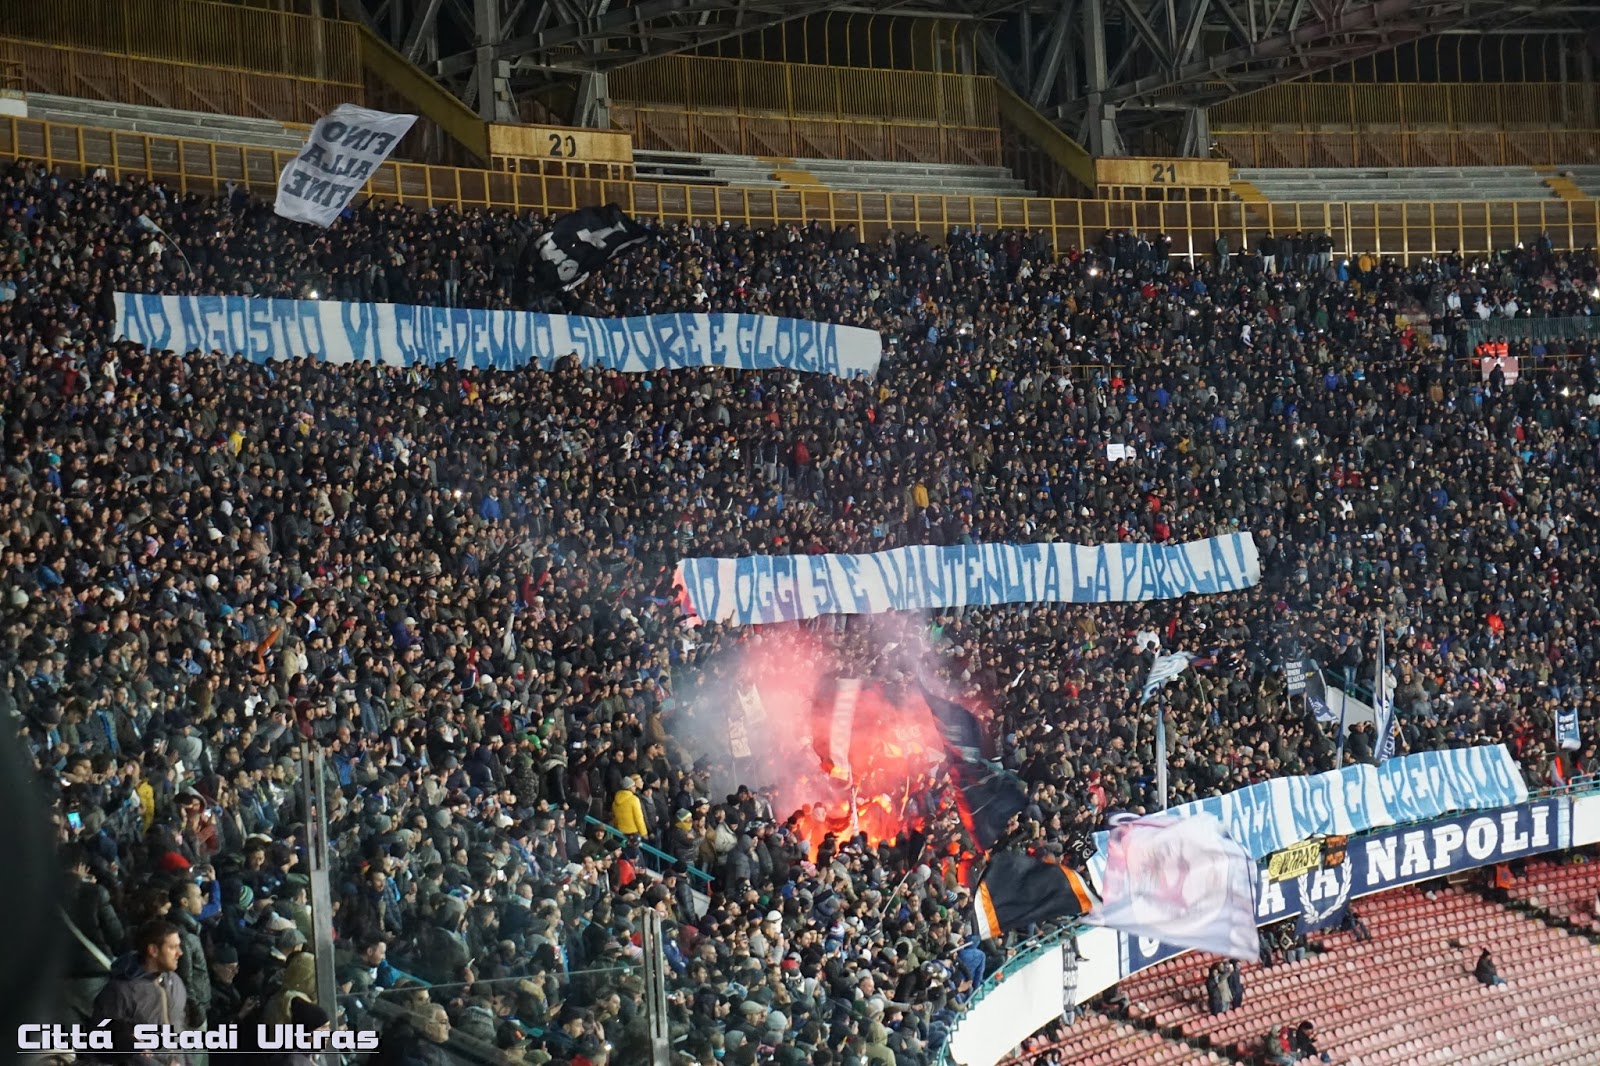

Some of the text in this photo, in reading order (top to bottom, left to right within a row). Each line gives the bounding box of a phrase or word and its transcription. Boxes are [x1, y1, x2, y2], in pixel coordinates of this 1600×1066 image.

[1152, 163, 1176, 183] 21
[124, 293, 171, 351] AD
[179, 295, 327, 363] AGOSTO
[341, 302, 383, 368] VI
[566, 316, 701, 372] SUDORE
[704, 313, 728, 368] E
[735, 555, 804, 623] OGGI
[1071, 543, 1110, 602] LA
[1120, 532, 1250, 600] PAROLA!
[1288, 774, 1336, 836] NOI
[1366, 810, 1550, 884] NAPOLI
